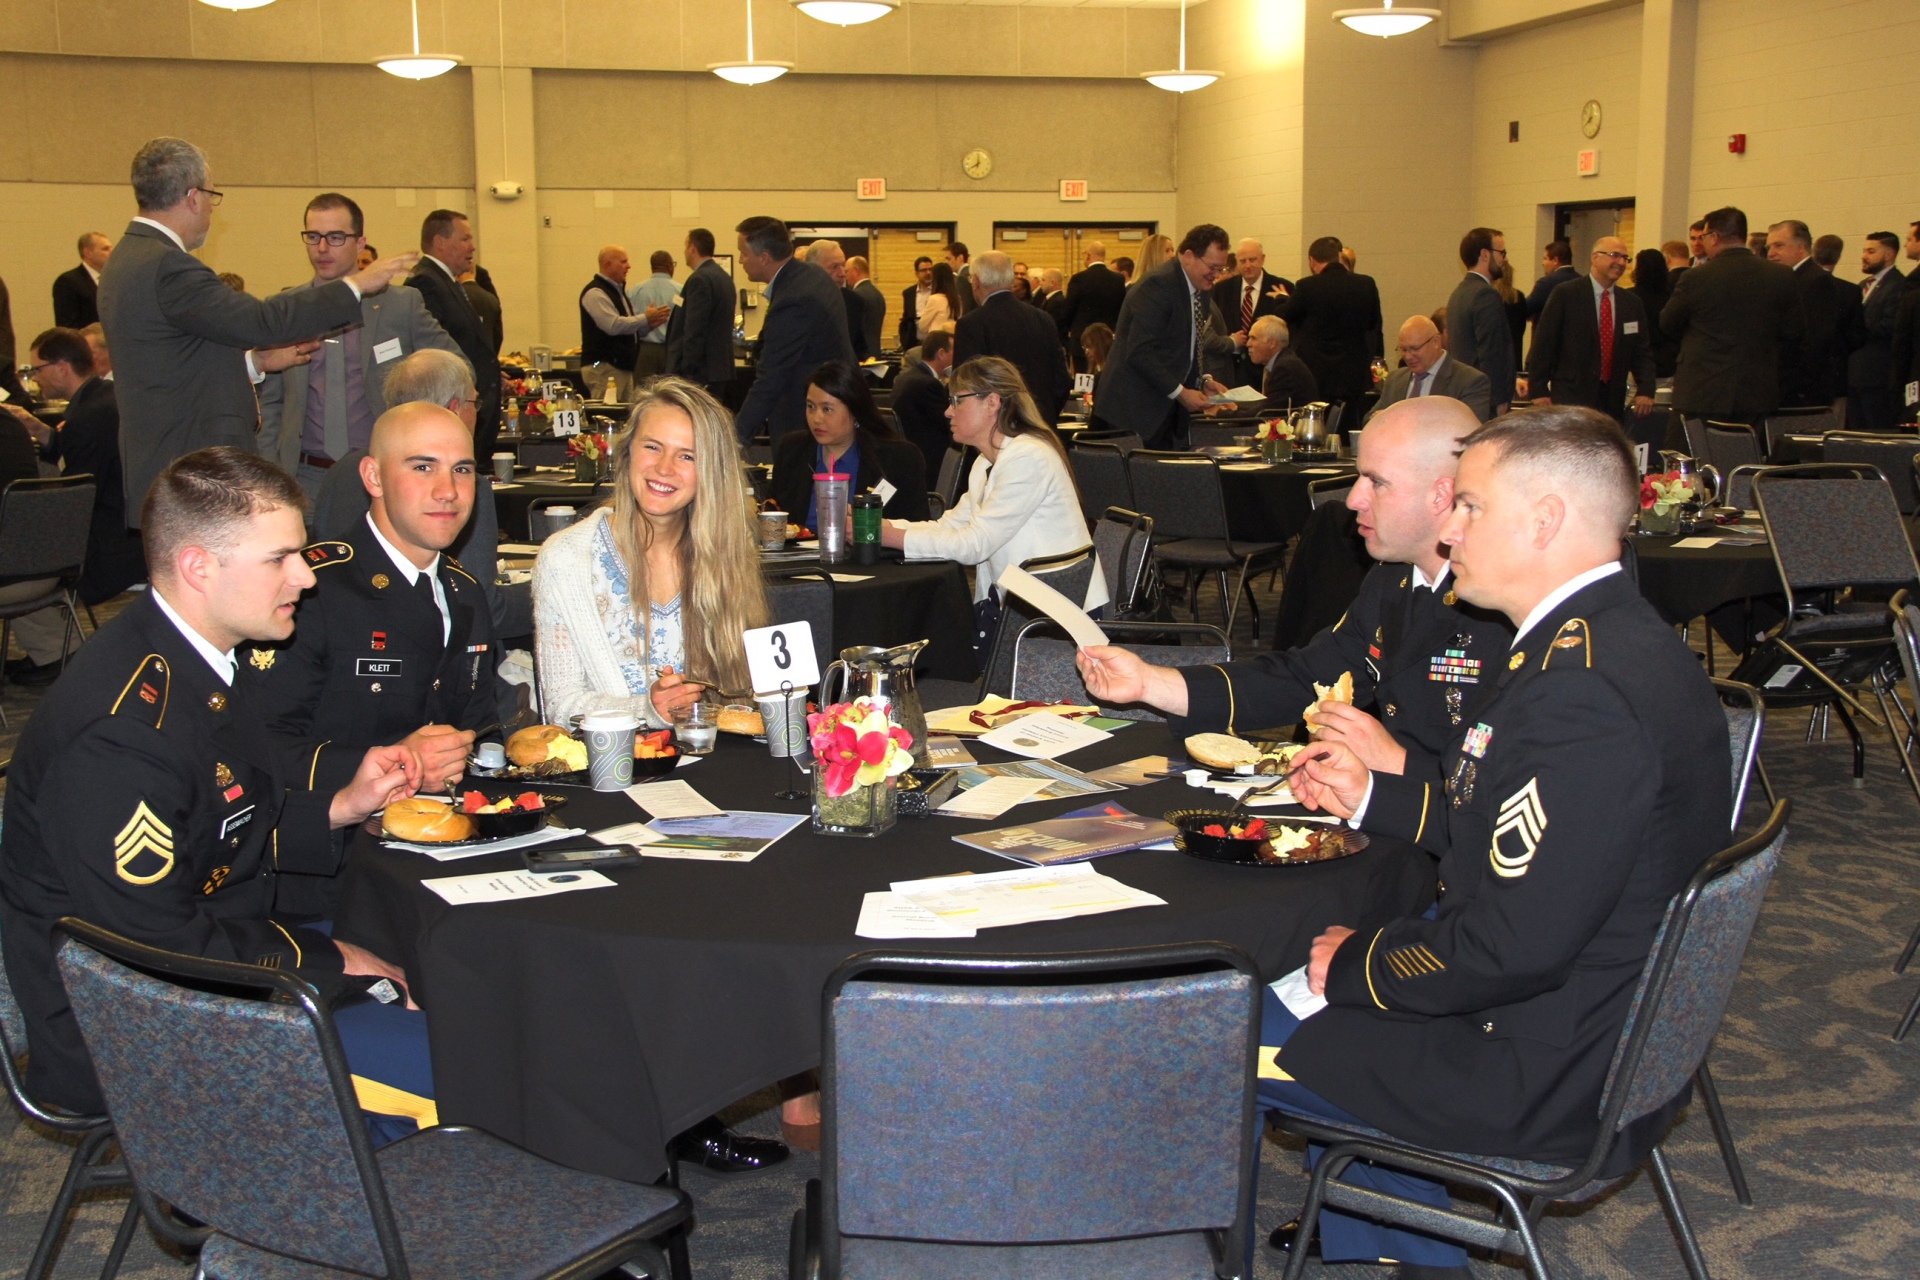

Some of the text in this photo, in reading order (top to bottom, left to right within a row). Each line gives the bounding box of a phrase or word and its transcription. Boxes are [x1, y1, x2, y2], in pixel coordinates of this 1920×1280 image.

[863, 180, 882, 196] EXIT
[1065, 182, 1085, 198] EXIT
[1079, 375, 1092, 387] 17
[558, 412, 575, 428] 13
[771, 630, 792, 670] 3
[368, 663, 391, 672] KLETT
